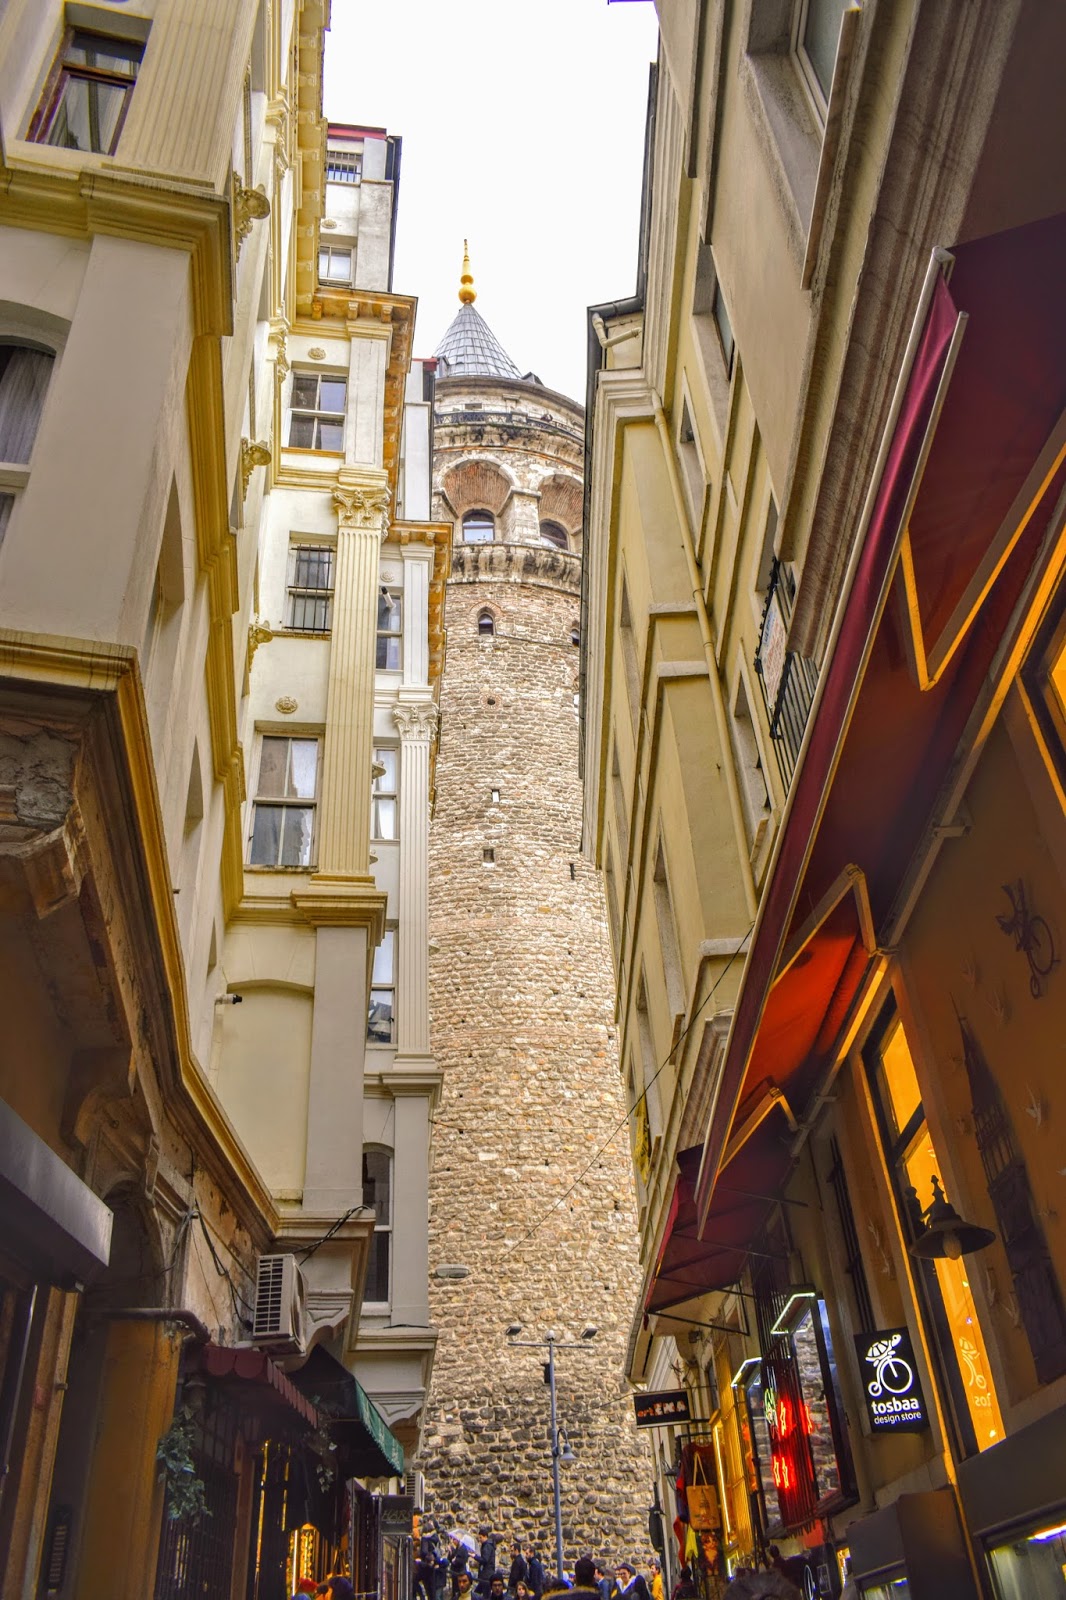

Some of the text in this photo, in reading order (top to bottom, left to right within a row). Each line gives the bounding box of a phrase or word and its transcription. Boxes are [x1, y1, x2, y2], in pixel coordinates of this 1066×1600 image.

[871, 1396, 920, 1415] tosbaa
[874, 1411, 922, 1425] design store
